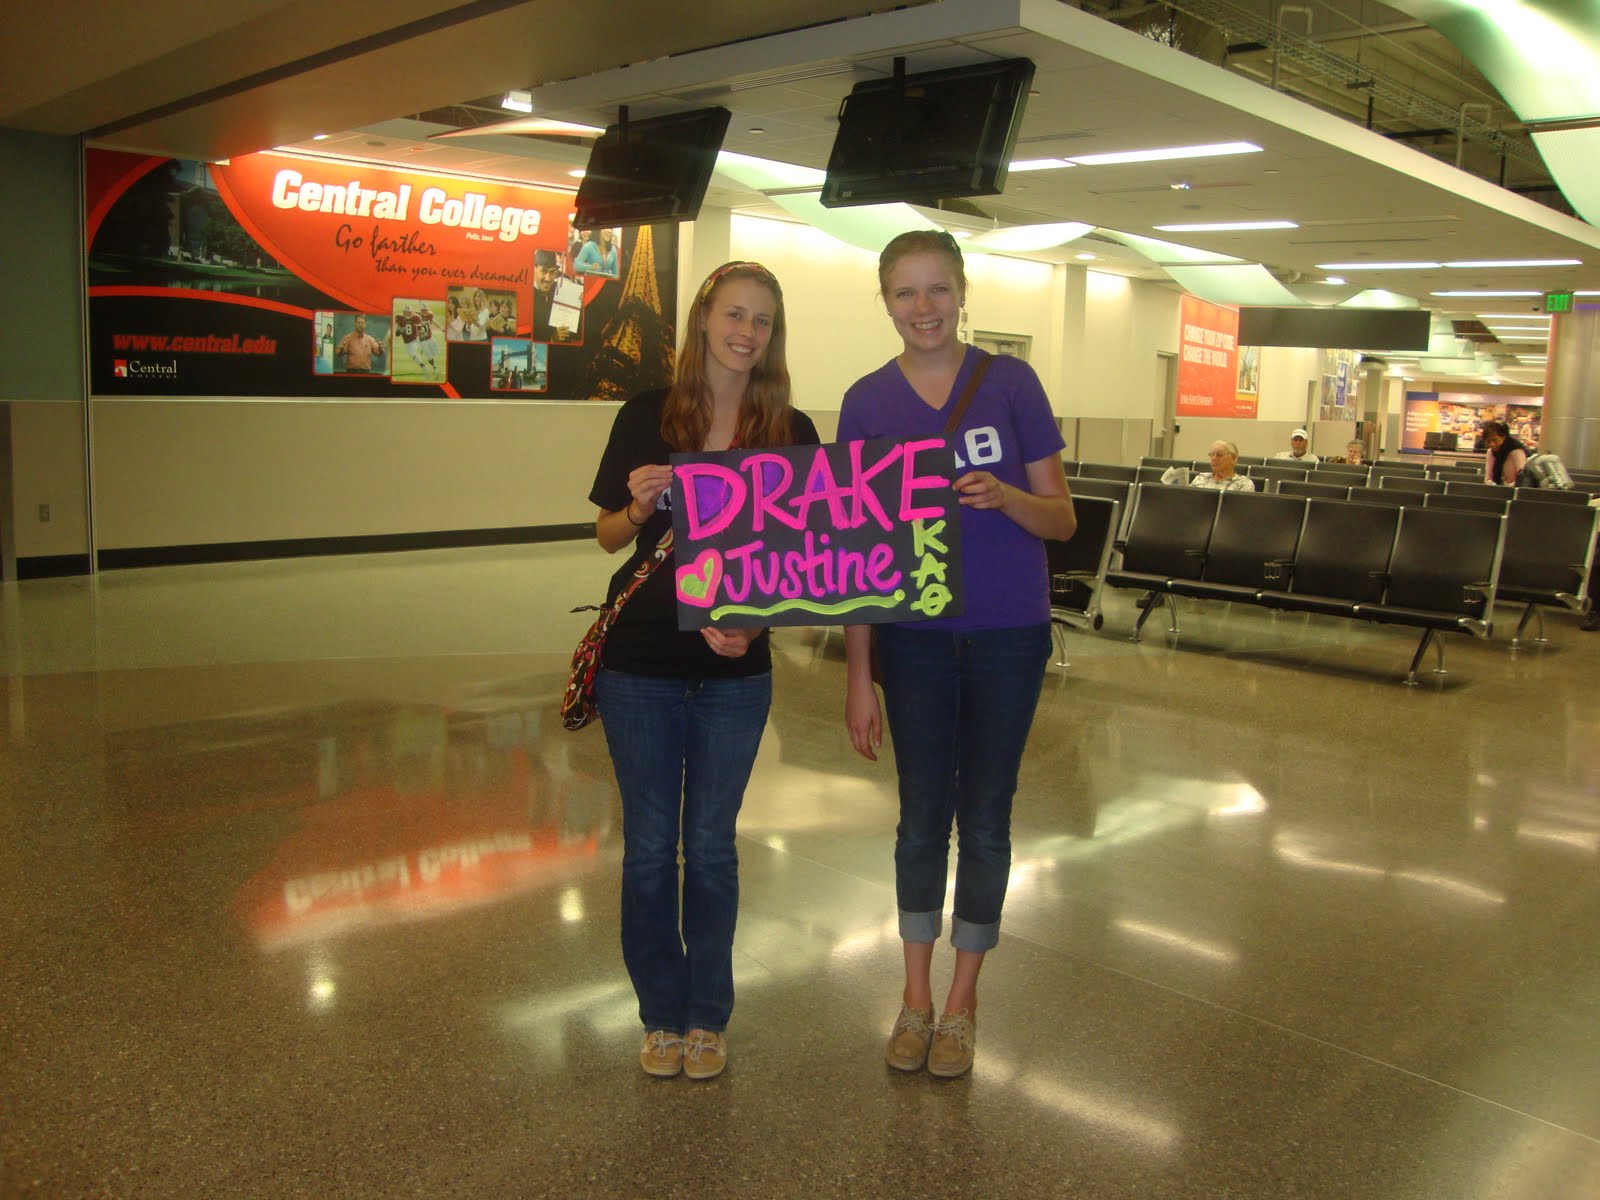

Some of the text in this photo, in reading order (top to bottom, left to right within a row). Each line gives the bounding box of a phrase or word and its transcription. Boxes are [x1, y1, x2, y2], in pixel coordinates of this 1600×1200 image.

[271, 169, 541, 242] Central College
[335, 224, 436, 258] Go farther
[375, 256, 528, 284] than you ever dreamed!
[1547, 294, 1569, 311] EXIT
[112, 334, 277, 354] www.central.edu
[129, 360, 177, 374] Central
[673, 438, 950, 540] DRAKE
[723, 531, 901, 602] Justine
